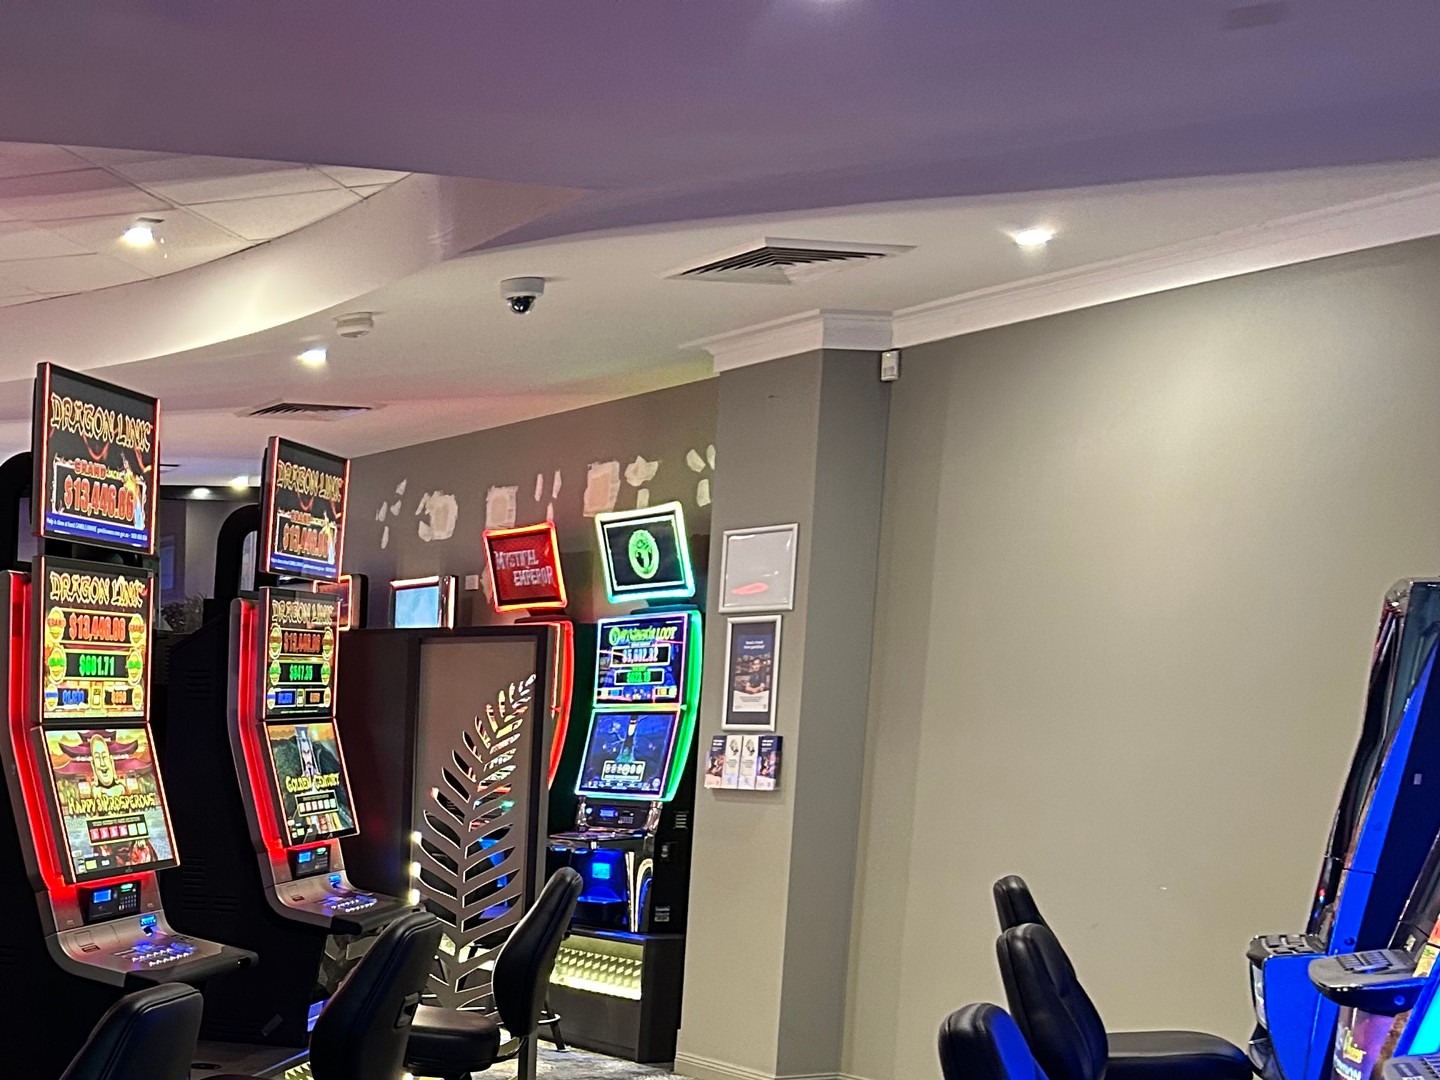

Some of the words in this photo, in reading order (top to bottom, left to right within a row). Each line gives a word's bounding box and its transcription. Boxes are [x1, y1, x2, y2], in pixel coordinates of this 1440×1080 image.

[51, 392, 115, 444] DRAGON
[116, 413, 151, 453] LINK
[74, 458, 107, 480] GRAND
[64, 474, 134, 521] $13,446.86
[50, 571, 110, 605] DRAGON
